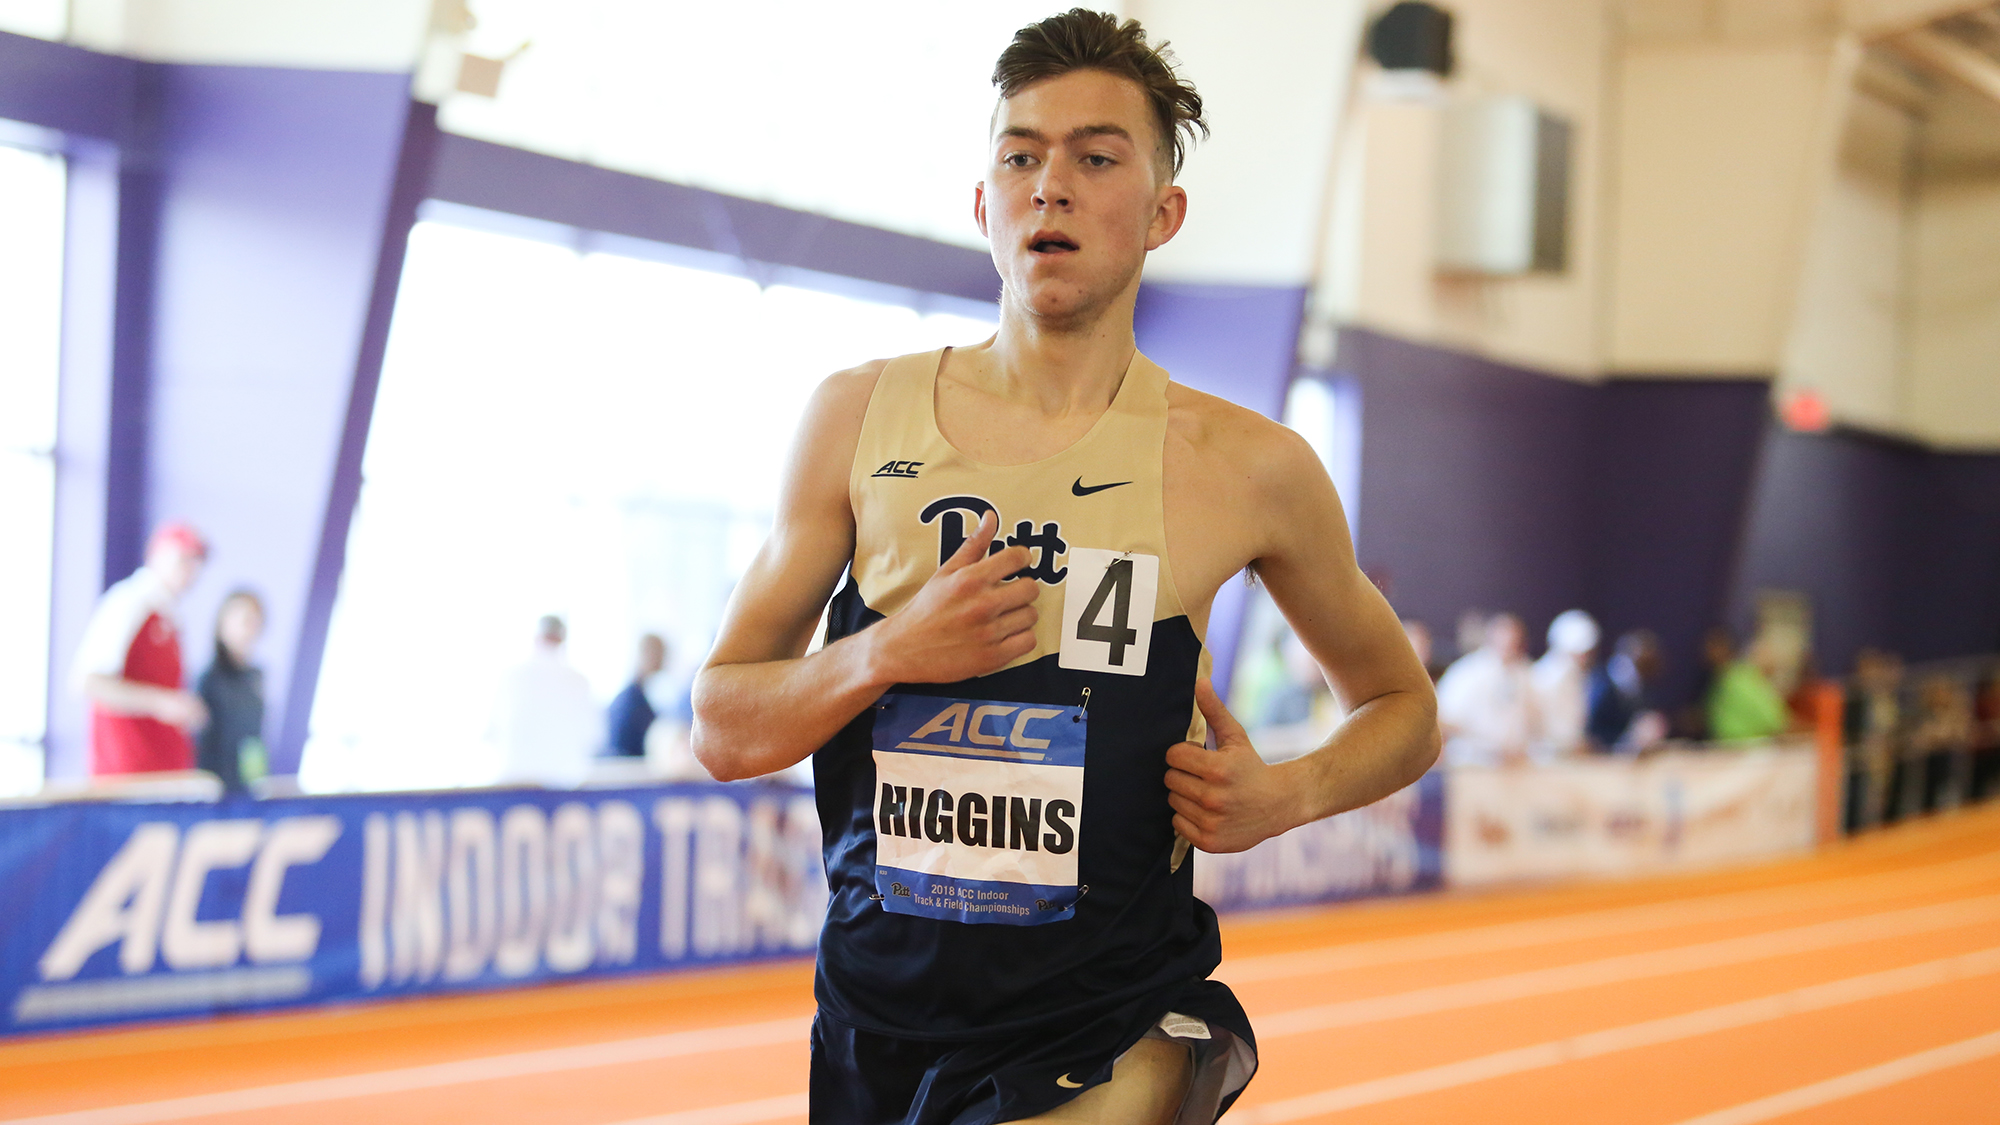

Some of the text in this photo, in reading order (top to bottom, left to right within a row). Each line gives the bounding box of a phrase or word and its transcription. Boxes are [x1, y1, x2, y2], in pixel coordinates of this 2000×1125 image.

[876, 460, 925, 475] ACC
[1076, 557, 1137, 667] 4
[908, 702, 1065, 750] ACC
[878, 782, 1076, 855] HIGGINS
[38, 813, 344, 982] ACC
[357, 796, 644, 993] INDOOR
[890, 882, 911, 897] Pitt
[914, 893, 1030, 917] Track & Field Championships
[931, 884, 1009, 901] 2018 ACC Indoor
